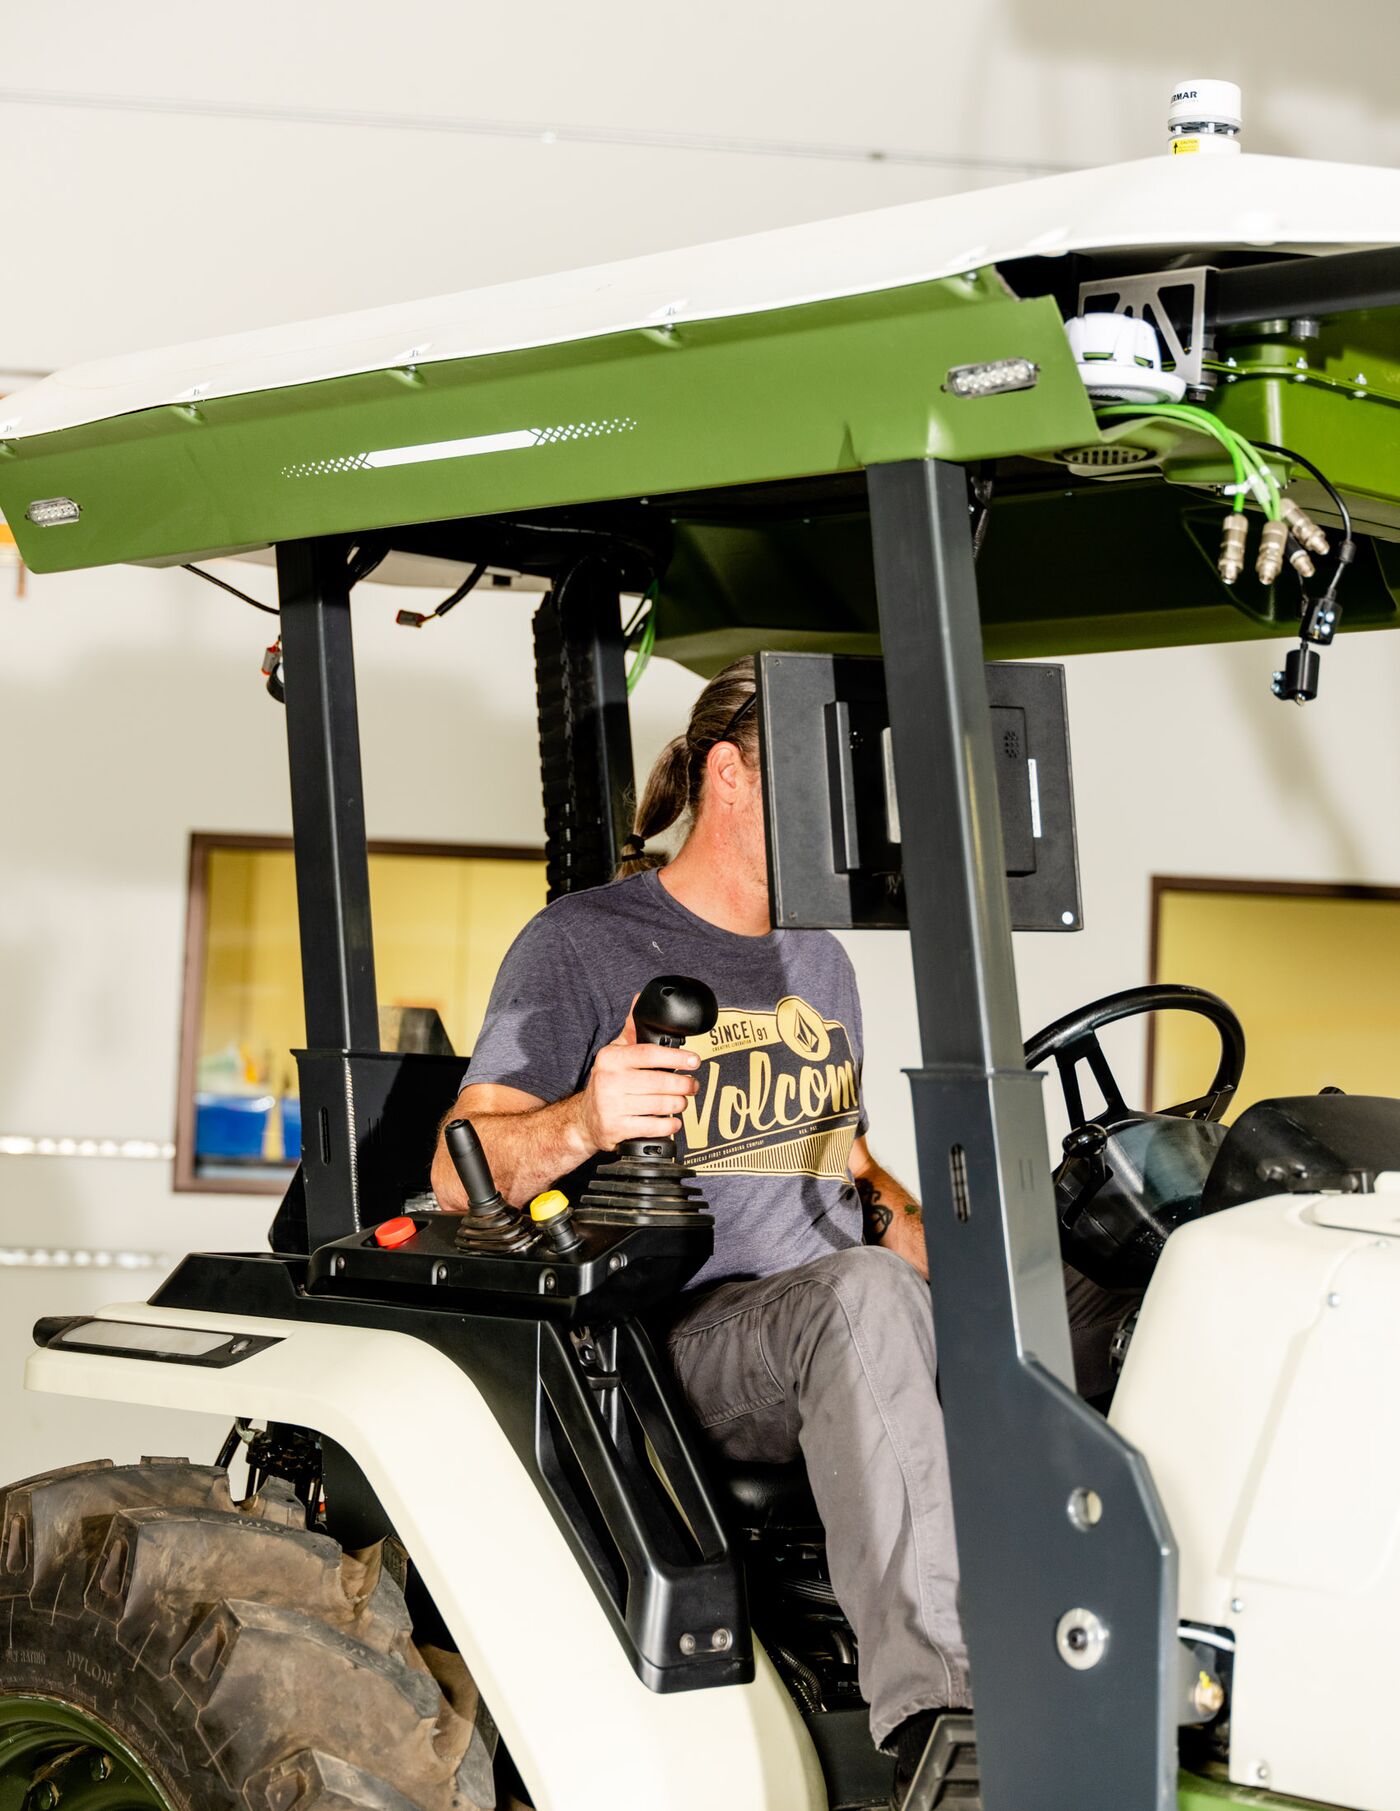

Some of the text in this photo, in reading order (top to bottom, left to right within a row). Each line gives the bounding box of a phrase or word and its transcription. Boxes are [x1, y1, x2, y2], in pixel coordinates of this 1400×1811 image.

[709, 1021, 768, 1046] SINCE 91
[681, 1051, 858, 1149] Volcom
[708, 1150, 721, 1159] FIRST
[722, 1144, 745, 1155] BOARDING
[746, 1139, 764, 1149] COMPANY
